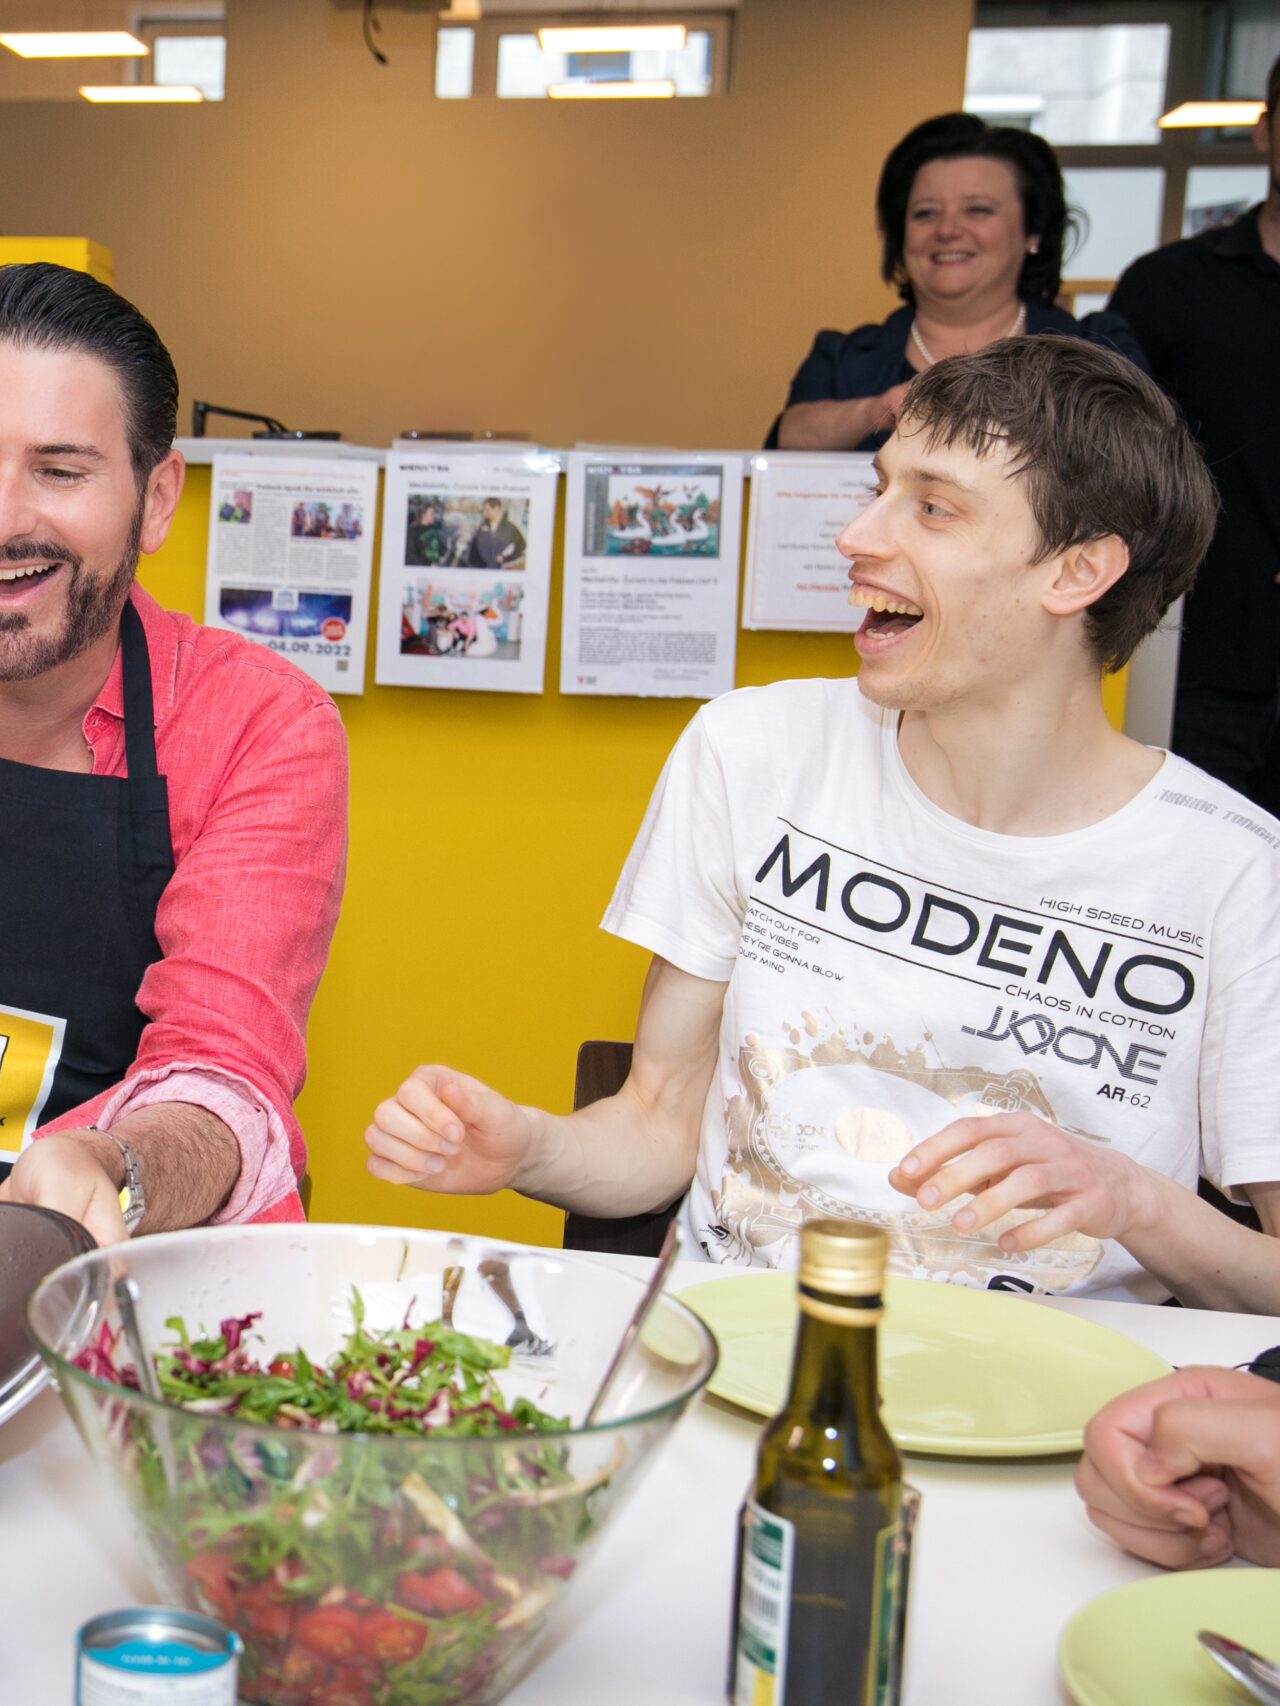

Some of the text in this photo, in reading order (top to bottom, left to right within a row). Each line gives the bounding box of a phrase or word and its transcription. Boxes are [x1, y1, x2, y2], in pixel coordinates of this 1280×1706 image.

[743, 919, 799, 951] HESE VIBES
[746, 906, 822, 945] ATCH OUT FOR
[754, 833, 1196, 1016] MODENO
[1039, 896, 1205, 949] HIGH SPEED MUSIC
[738, 945, 786, 974] OUR MIND
[741, 933, 845, 982] HEY'RE GONNA BLOW
[1005, 983, 1177, 1041] CHAOS IN COTTON
[1096, 1083, 1152, 1110] AR-62
